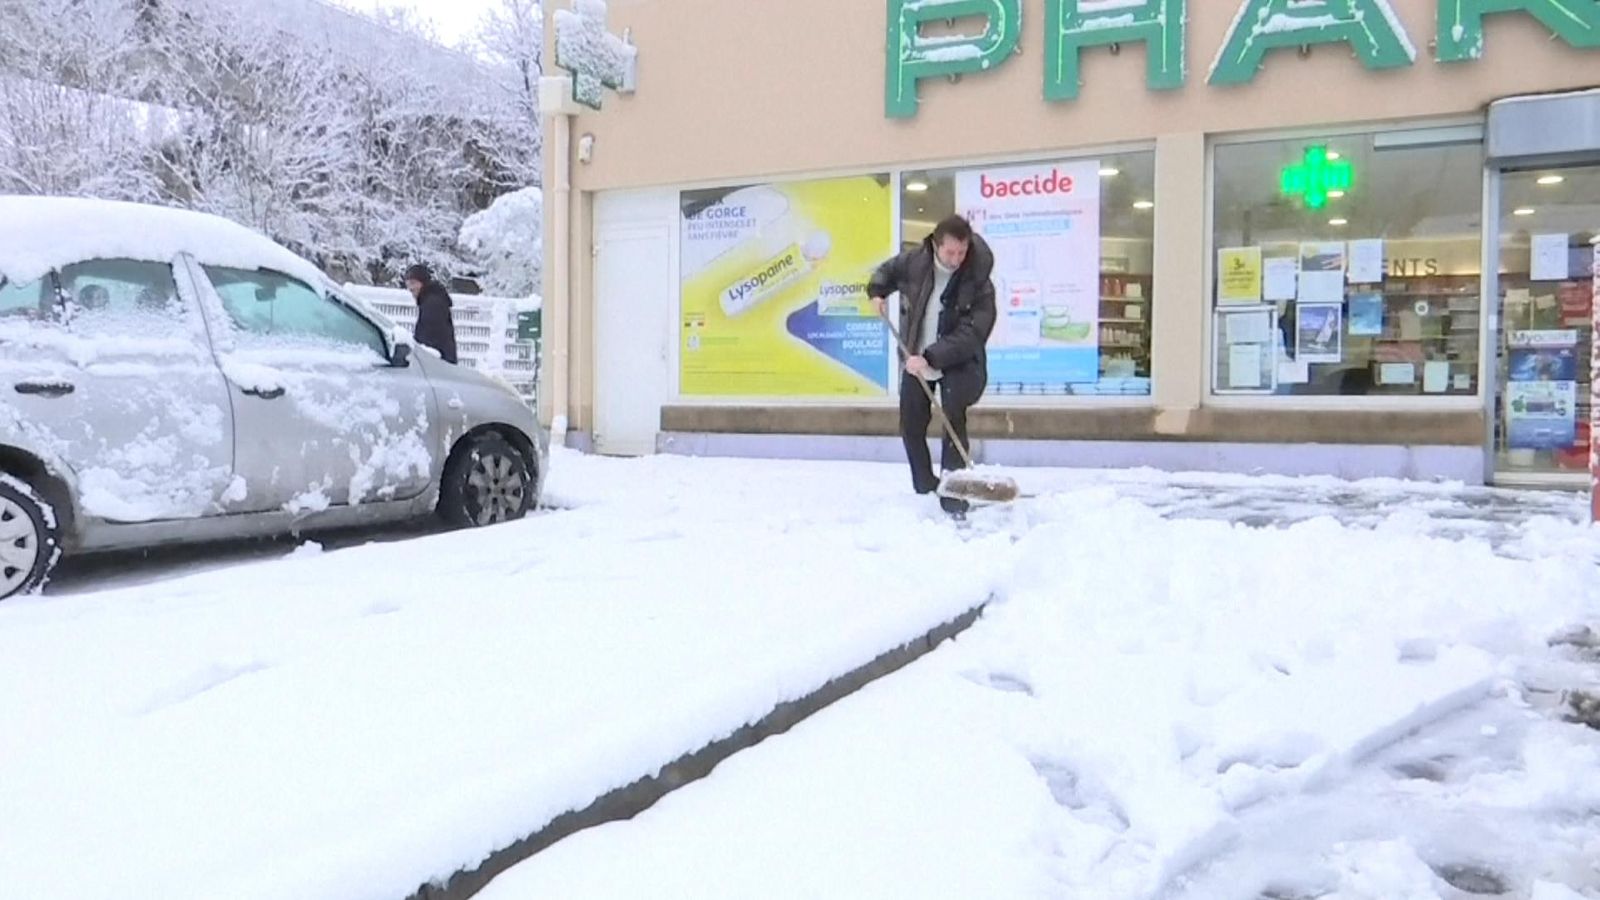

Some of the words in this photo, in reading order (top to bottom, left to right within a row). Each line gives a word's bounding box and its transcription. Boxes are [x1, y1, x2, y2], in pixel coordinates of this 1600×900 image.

[980, 168, 1073, 199] baccide
[706, 206, 746, 219] GORGE
[728, 254, 793, 301] Lysopaine
[820, 282, 868, 296] Lysopain
